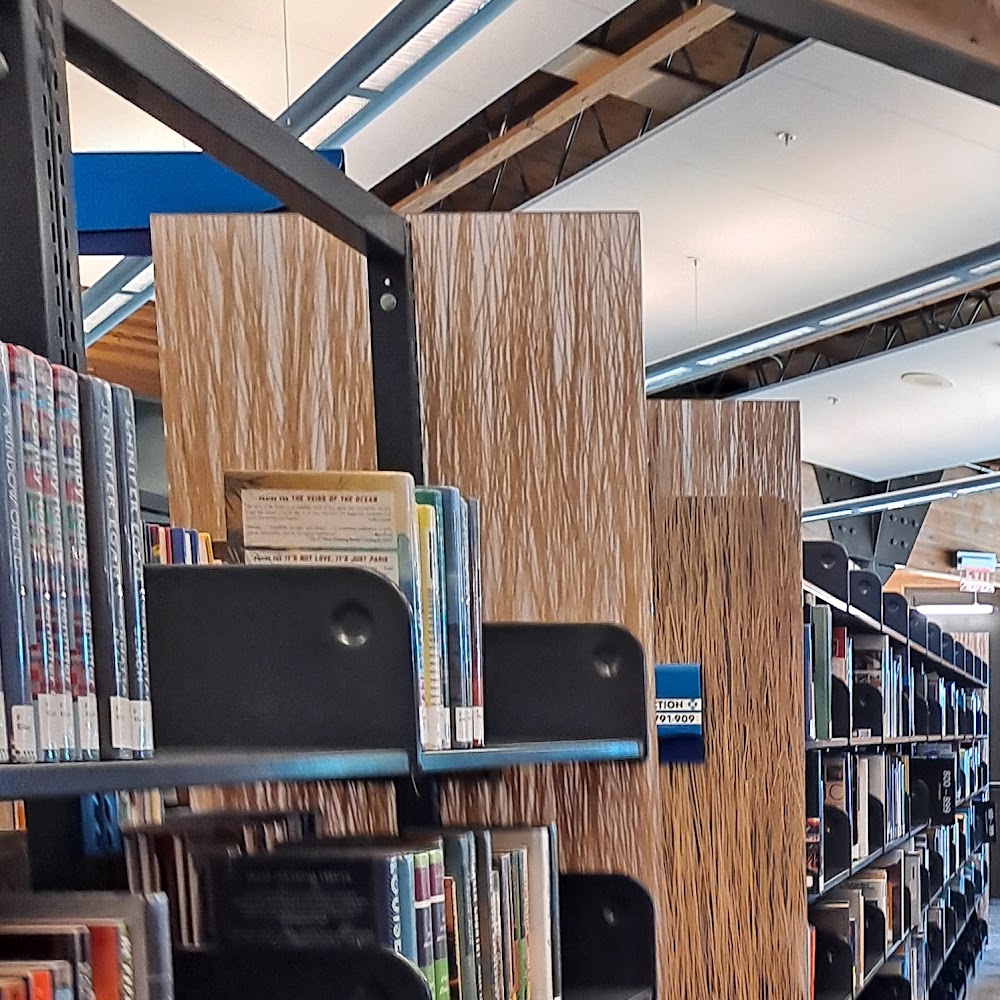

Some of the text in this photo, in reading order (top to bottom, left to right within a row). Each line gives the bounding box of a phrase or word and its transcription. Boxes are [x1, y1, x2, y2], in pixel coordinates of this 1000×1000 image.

[70, 433, 86, 499] Candy
[99, 399, 116, 508] JENNIFER
[123, 406, 138, 514] JENNIFER
[656, 701, 684, 709] TION
